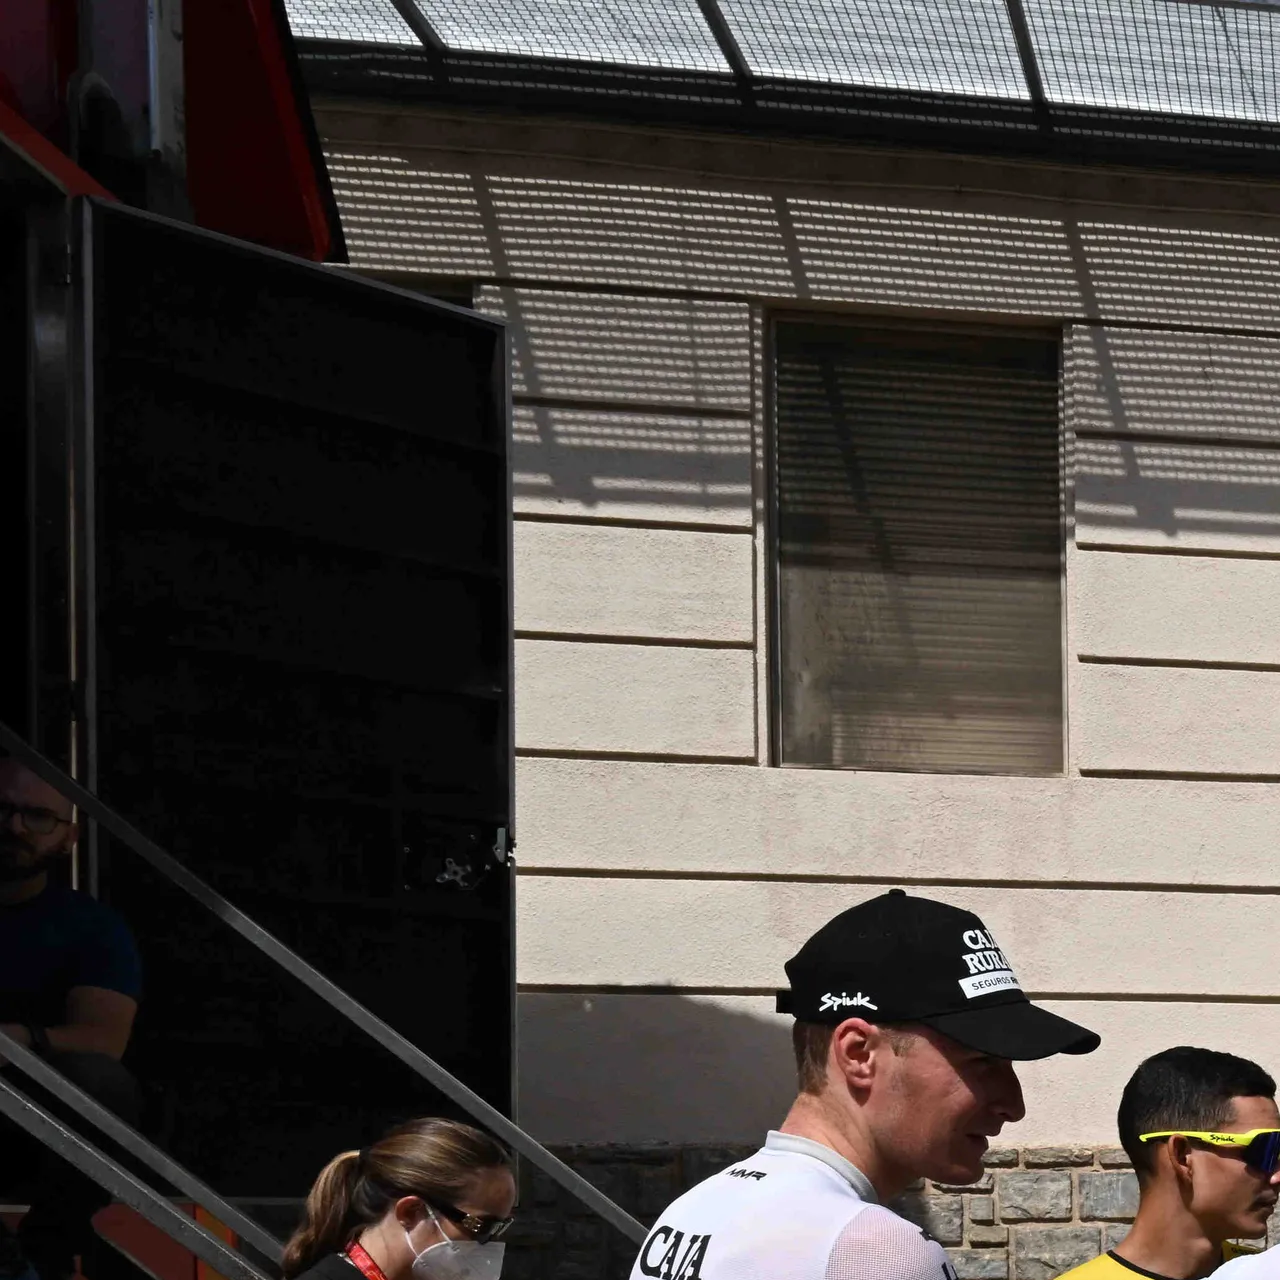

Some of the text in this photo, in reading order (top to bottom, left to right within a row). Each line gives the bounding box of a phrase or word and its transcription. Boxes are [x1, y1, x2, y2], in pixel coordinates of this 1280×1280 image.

[962, 929, 999, 951] CAJ
[962, 951, 1013, 975] RURA
[971, 977, 1010, 991] SEGUROS
[819, 992, 878, 1011] Spiuk
[726, 1168, 767, 1181] MMR
